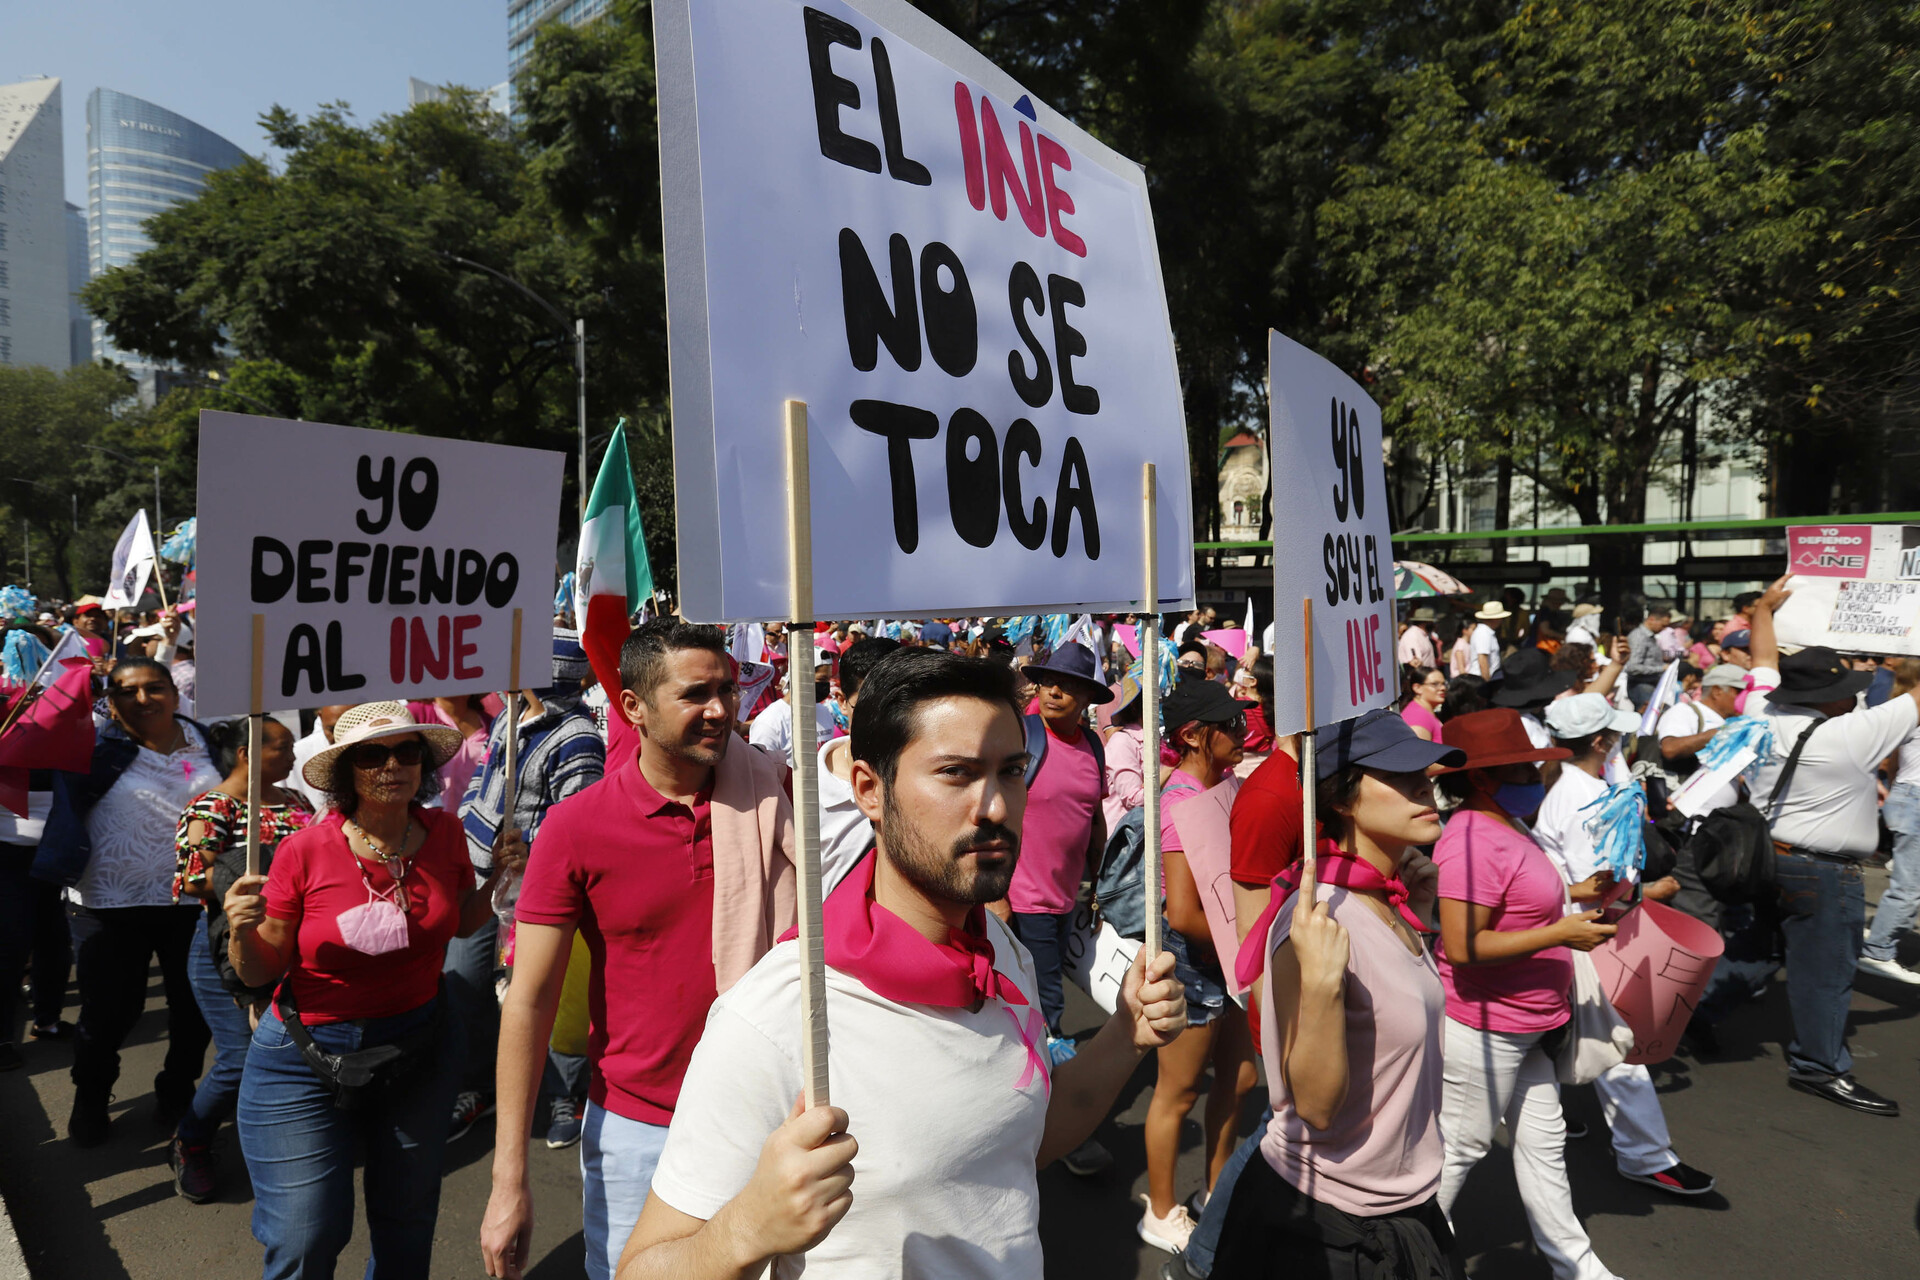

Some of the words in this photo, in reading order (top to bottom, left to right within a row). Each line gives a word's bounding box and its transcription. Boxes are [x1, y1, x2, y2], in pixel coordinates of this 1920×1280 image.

[138, 122, 182, 138] REGIS
[804, 6, 931, 186] EL
[954, 81, 1086, 258] INE
[839, 227, 978, 378] NO
[1008, 260, 1099, 415] SE
[356, 455, 439, 534] YO
[849, 398, 1099, 561] TOCA
[1331, 396, 1364, 523] YO
[1323, 532, 1362, 607] SOY
[1364, 534, 1384, 604] EL
[1798, 536, 1862, 545] DEFIENDO
[1820, 528, 1839, 536] YO
[1820, 555, 1865, 568] INE
[251, 536, 519, 608] DEFIENDO
[282, 620, 367, 697] AL
[390, 614, 484, 684] INE
[1346, 614, 1384, 706] INE
